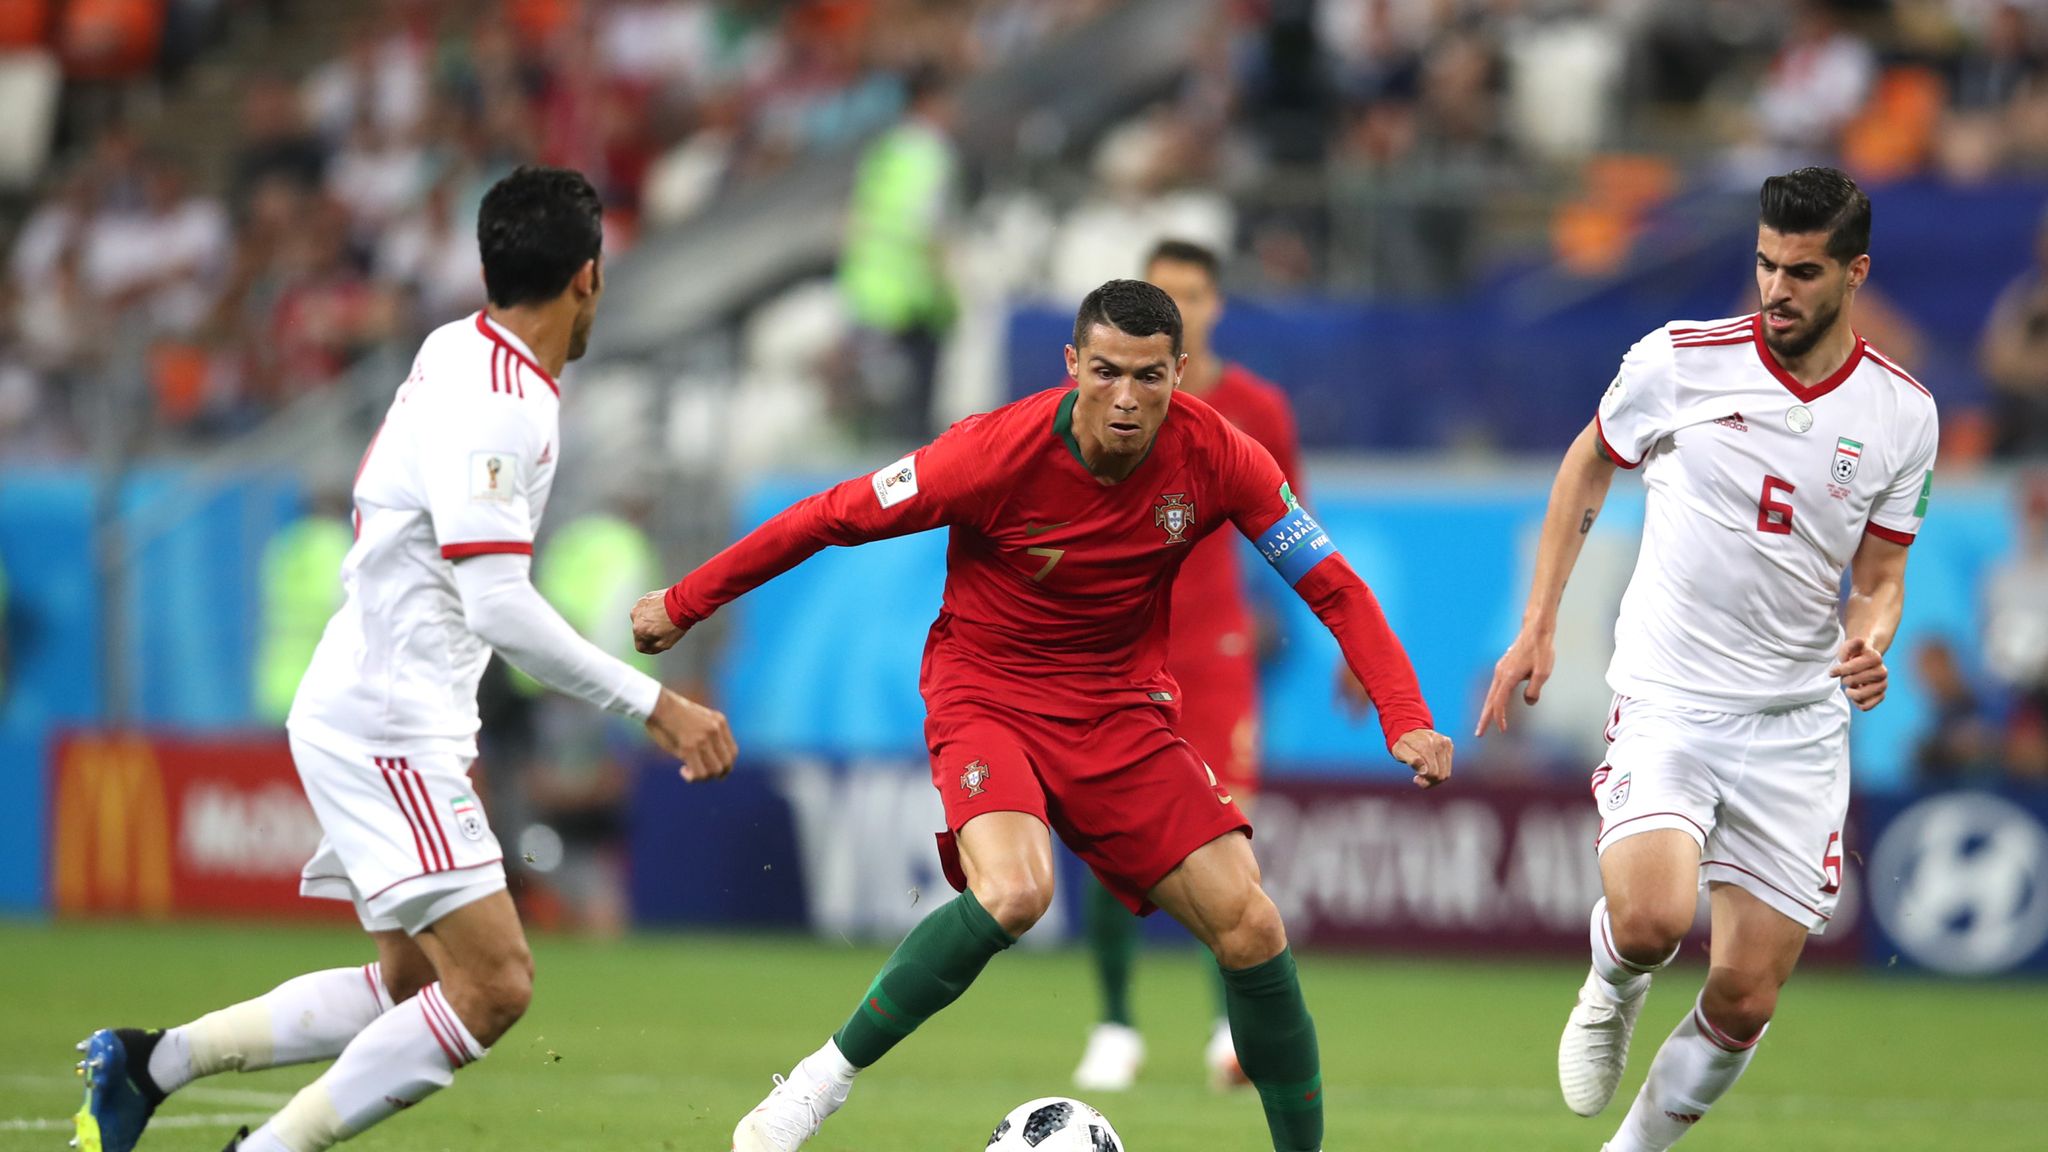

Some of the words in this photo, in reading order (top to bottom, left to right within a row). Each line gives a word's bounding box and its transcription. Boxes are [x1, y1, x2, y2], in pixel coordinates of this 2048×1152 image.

[1757, 474, 1796, 535] 6
[1262, 513, 1312, 556] LIVING
[1310, 534, 1329, 550] FIFA
[1027, 547, 1066, 582] 7
